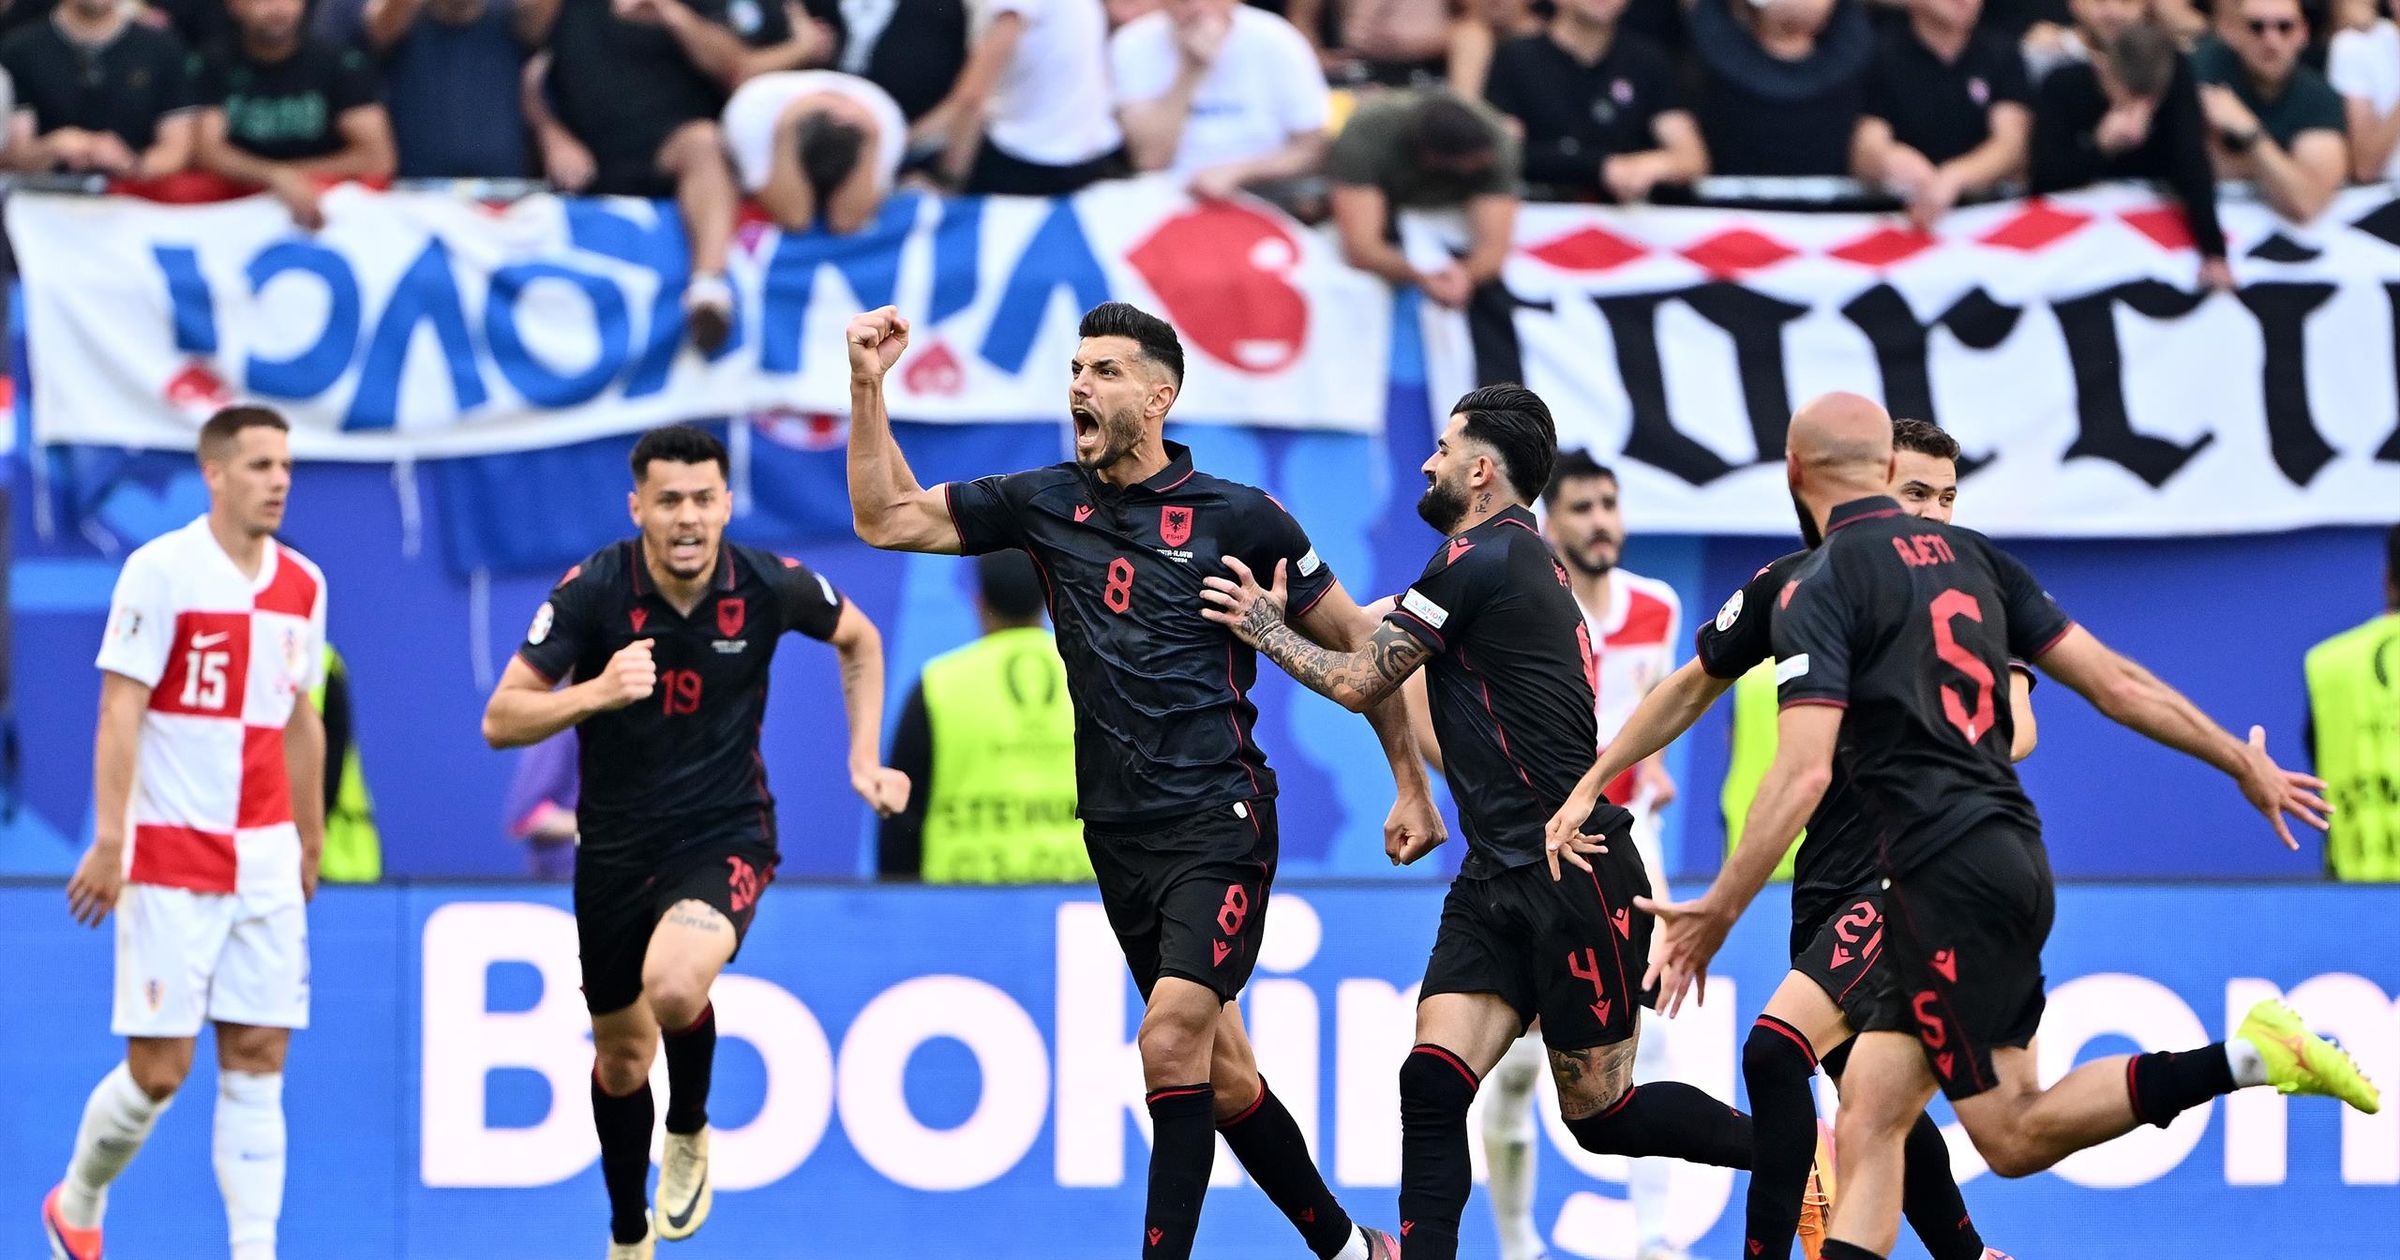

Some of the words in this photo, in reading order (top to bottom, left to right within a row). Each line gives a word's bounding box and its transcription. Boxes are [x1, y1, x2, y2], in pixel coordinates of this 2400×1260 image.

[1892, 534, 1956, 568] AJETI
[1104, 556, 1136, 614] 8
[180, 649, 230, 710] 15
[661, 668, 704, 716] 19
[1929, 587, 1995, 746] 5
[1217, 883, 1250, 937] 8
[1567, 946, 1604, 998] 4
[1911, 990, 1948, 1050] 5
